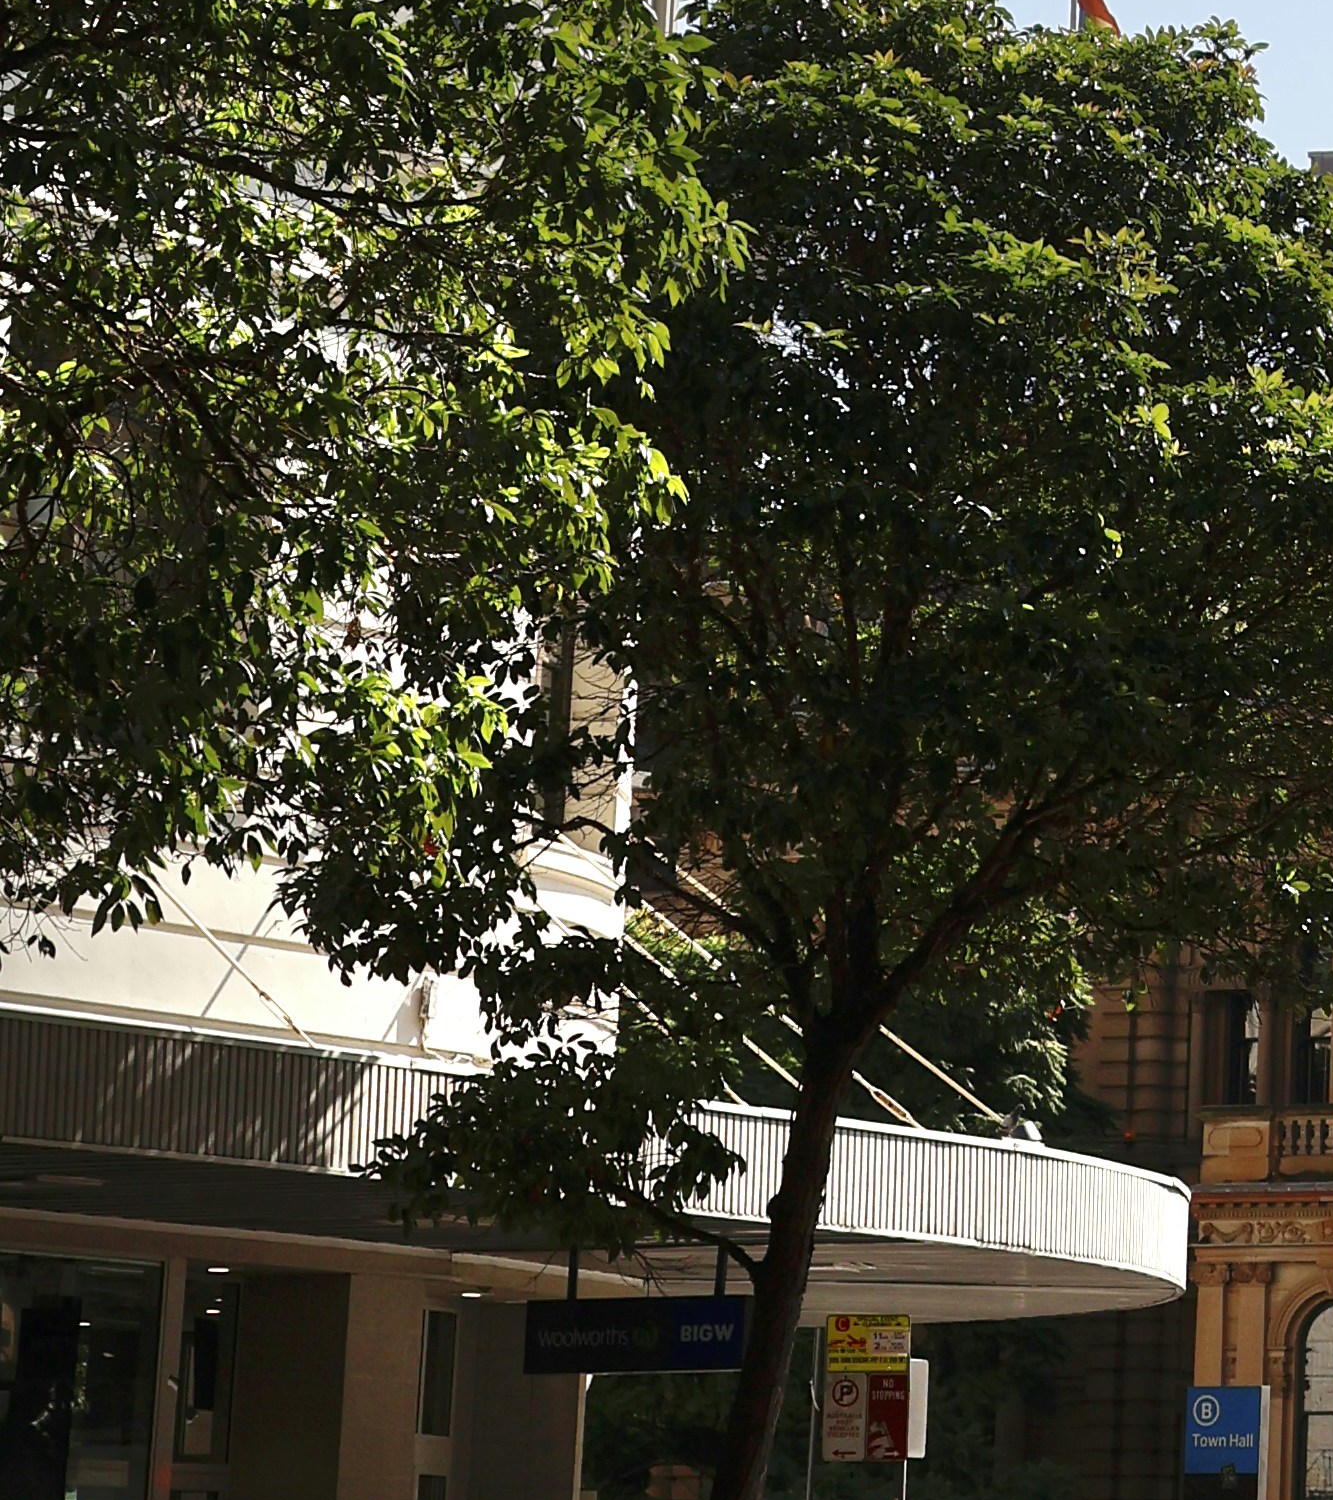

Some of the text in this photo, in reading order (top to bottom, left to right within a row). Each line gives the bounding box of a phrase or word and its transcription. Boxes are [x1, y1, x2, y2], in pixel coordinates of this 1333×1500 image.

[882, 1378, 894, 1387] NO
[872, 1390, 905, 1400] STOPPING
[1192, 1433, 1254, 1448] Town Hall
